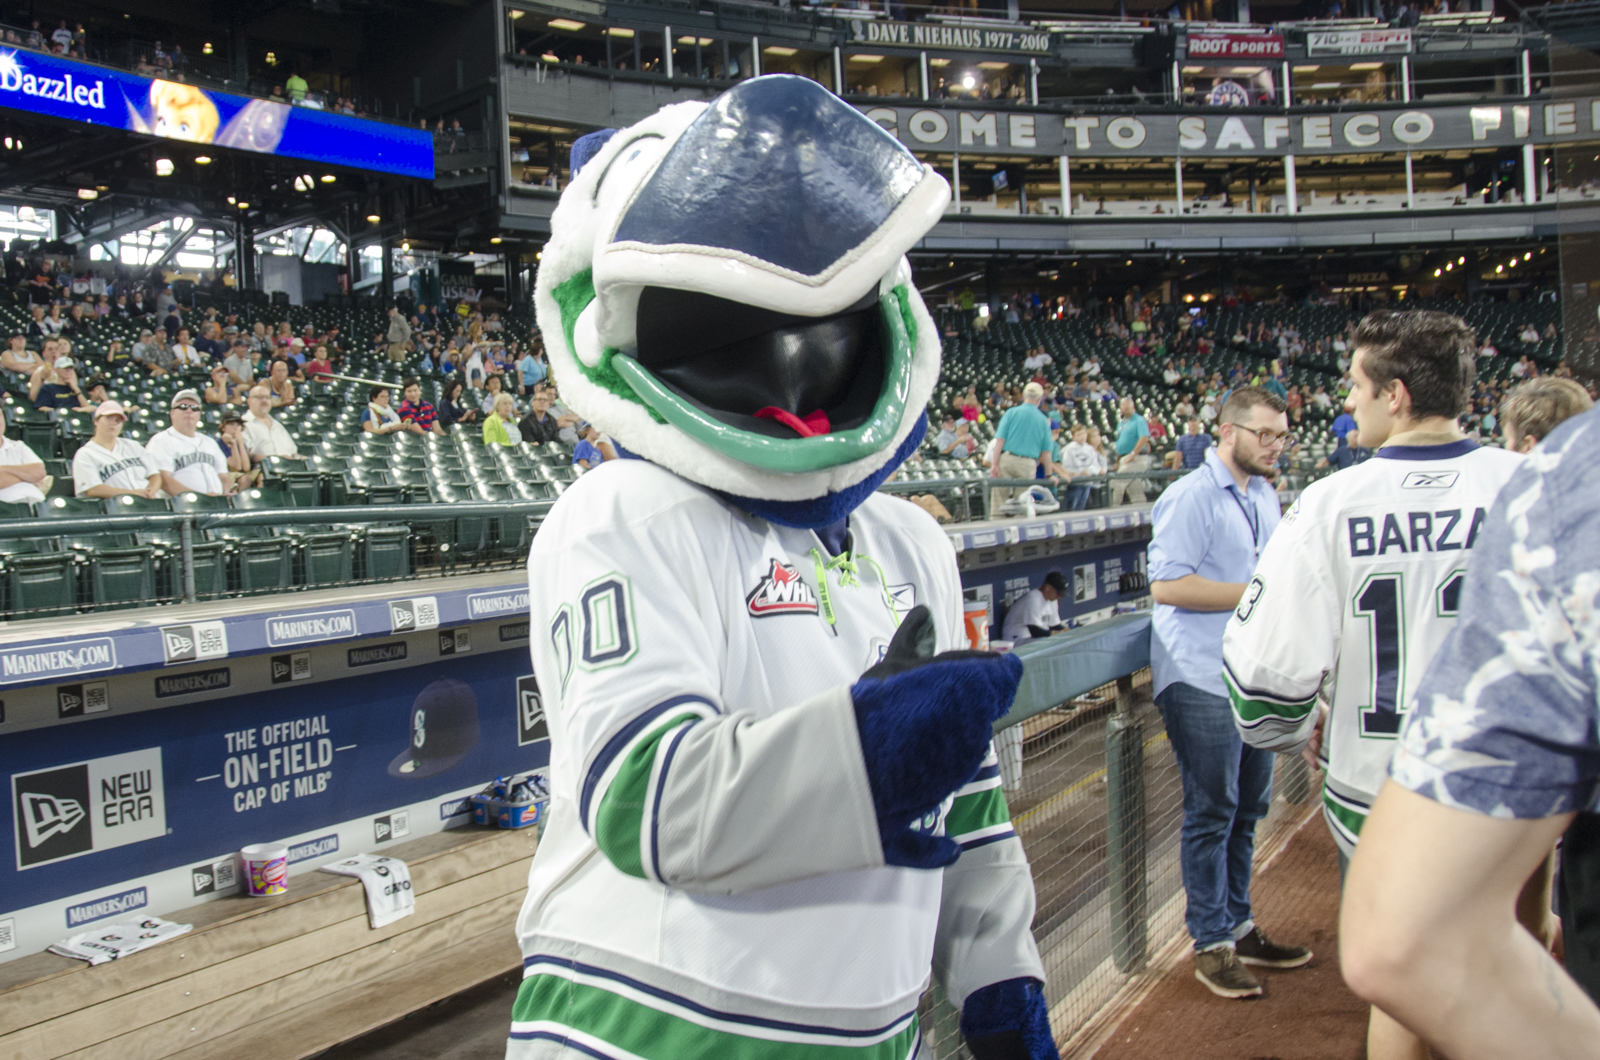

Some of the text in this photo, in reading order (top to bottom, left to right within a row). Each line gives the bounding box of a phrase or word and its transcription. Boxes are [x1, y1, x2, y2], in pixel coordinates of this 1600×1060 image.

[867, 22, 1049, 51] DAVE NIEHAUS 1977-2010
[1189, 38, 1281, 54] ROOT SPORTS
[1313, 33, 1340, 45] 710
[1360, 30, 1409, 44] ESPN
[0, 65, 106, 109] Dazzled
[1064, 116, 1147, 149] TO
[1178, 110, 1434, 149] SAFECO
[766, 579, 817, 604] WHL
[416, 603, 435, 616] NEW
[419, 613, 436, 625] ERA
[199, 628, 223, 641] NEW
[200, 639, 224, 653] ERA
[86, 687, 105, 699] NEW
[87, 698, 106, 708] ERA
[224, 715, 330, 753] THE OFFICIAL
[224, 738, 333, 789] ON-FIELD
[101, 769, 152, 802] NEW
[233, 787, 267, 813] CAP
[271, 781, 290, 803] OF
[103, 795, 154, 828] ERA
